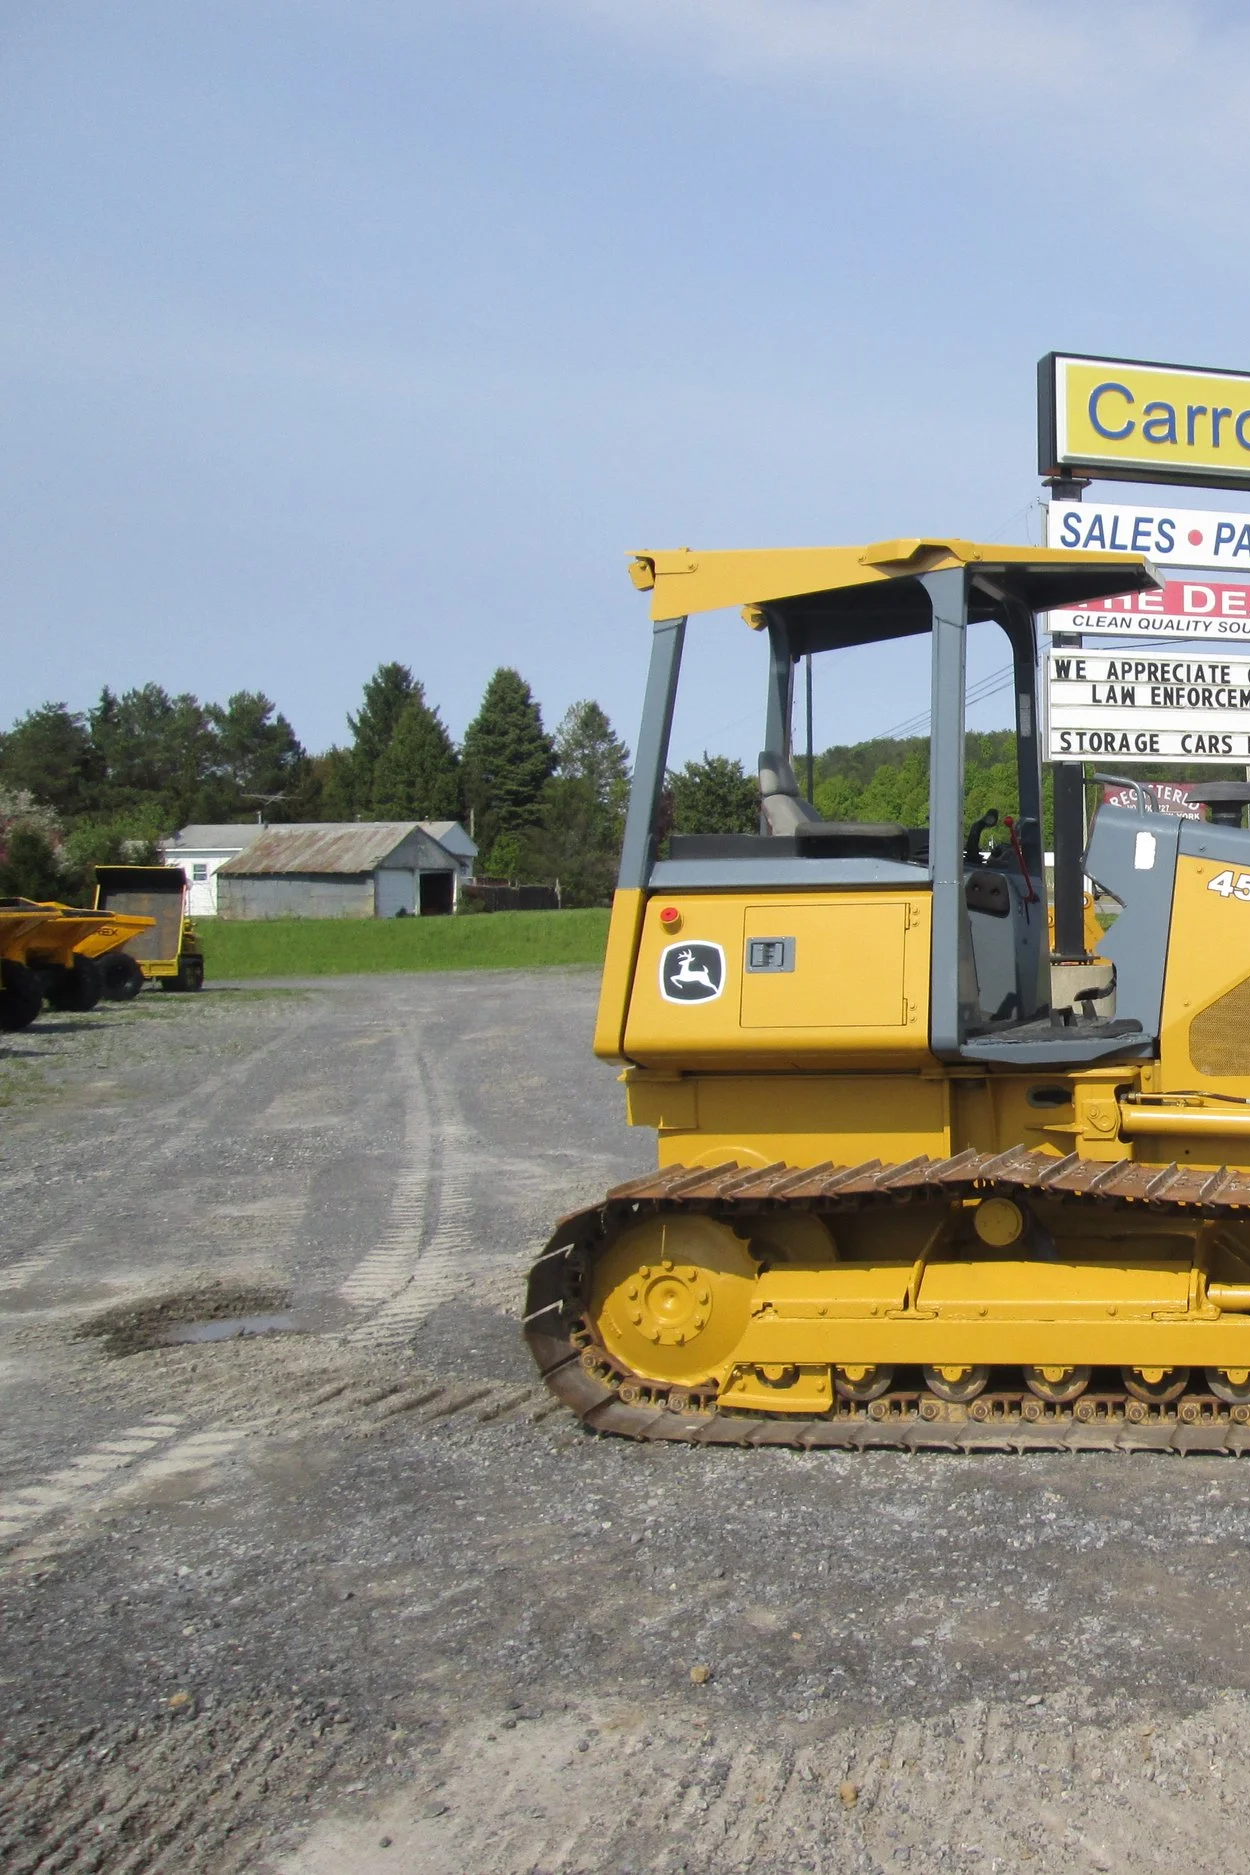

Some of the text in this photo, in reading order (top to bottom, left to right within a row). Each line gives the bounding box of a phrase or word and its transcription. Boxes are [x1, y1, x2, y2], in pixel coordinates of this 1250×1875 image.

[1060, 512, 1176, 553] SALES
[1078, 589, 1164, 611] HE
[1072, 615, 1132, 629] CLEAN
[1138, 618, 1212, 632] QUALITY
[1055, 659, 1086, 679] WE
[1107, 661, 1231, 684] APPRECIATE
[1092, 684, 1135, 705] LAW
[1060, 731, 1160, 752] STORAGE
[1181, 734, 1232, 754] CARS
